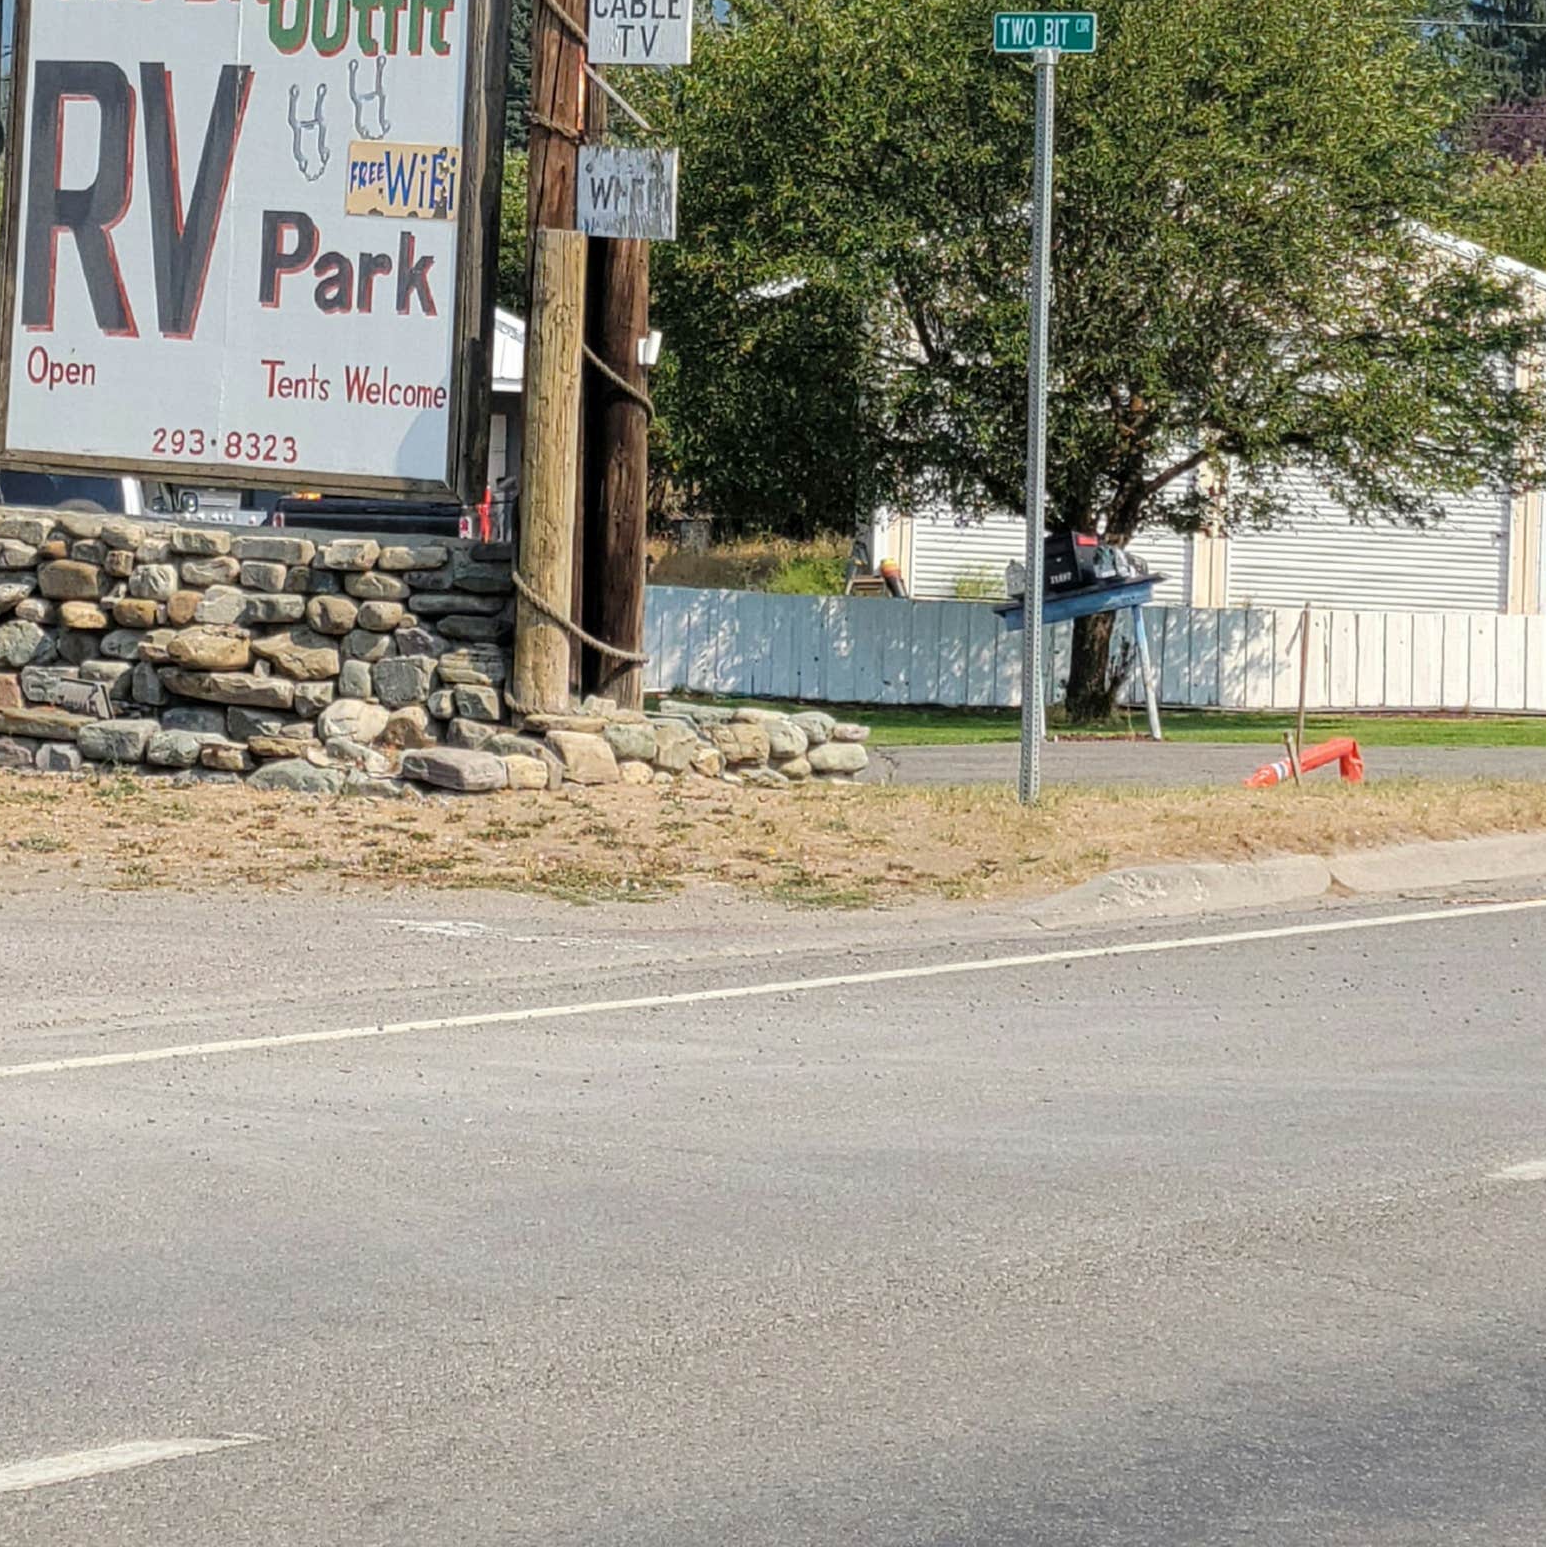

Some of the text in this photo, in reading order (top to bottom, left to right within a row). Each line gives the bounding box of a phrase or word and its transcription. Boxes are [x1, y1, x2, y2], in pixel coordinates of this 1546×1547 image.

[616, 24, 659, 58] TV
[1000, 18, 1037, 45] TWO
[1043, 18, 1070, 45] BIT
[21, 60, 256, 340] RV
[350, 150, 456, 211] FREE WiFi
[259, 210, 438, 317] Park
[27, 346, 96, 391] Open
[261, 359, 447, 410] Tents Welcome
